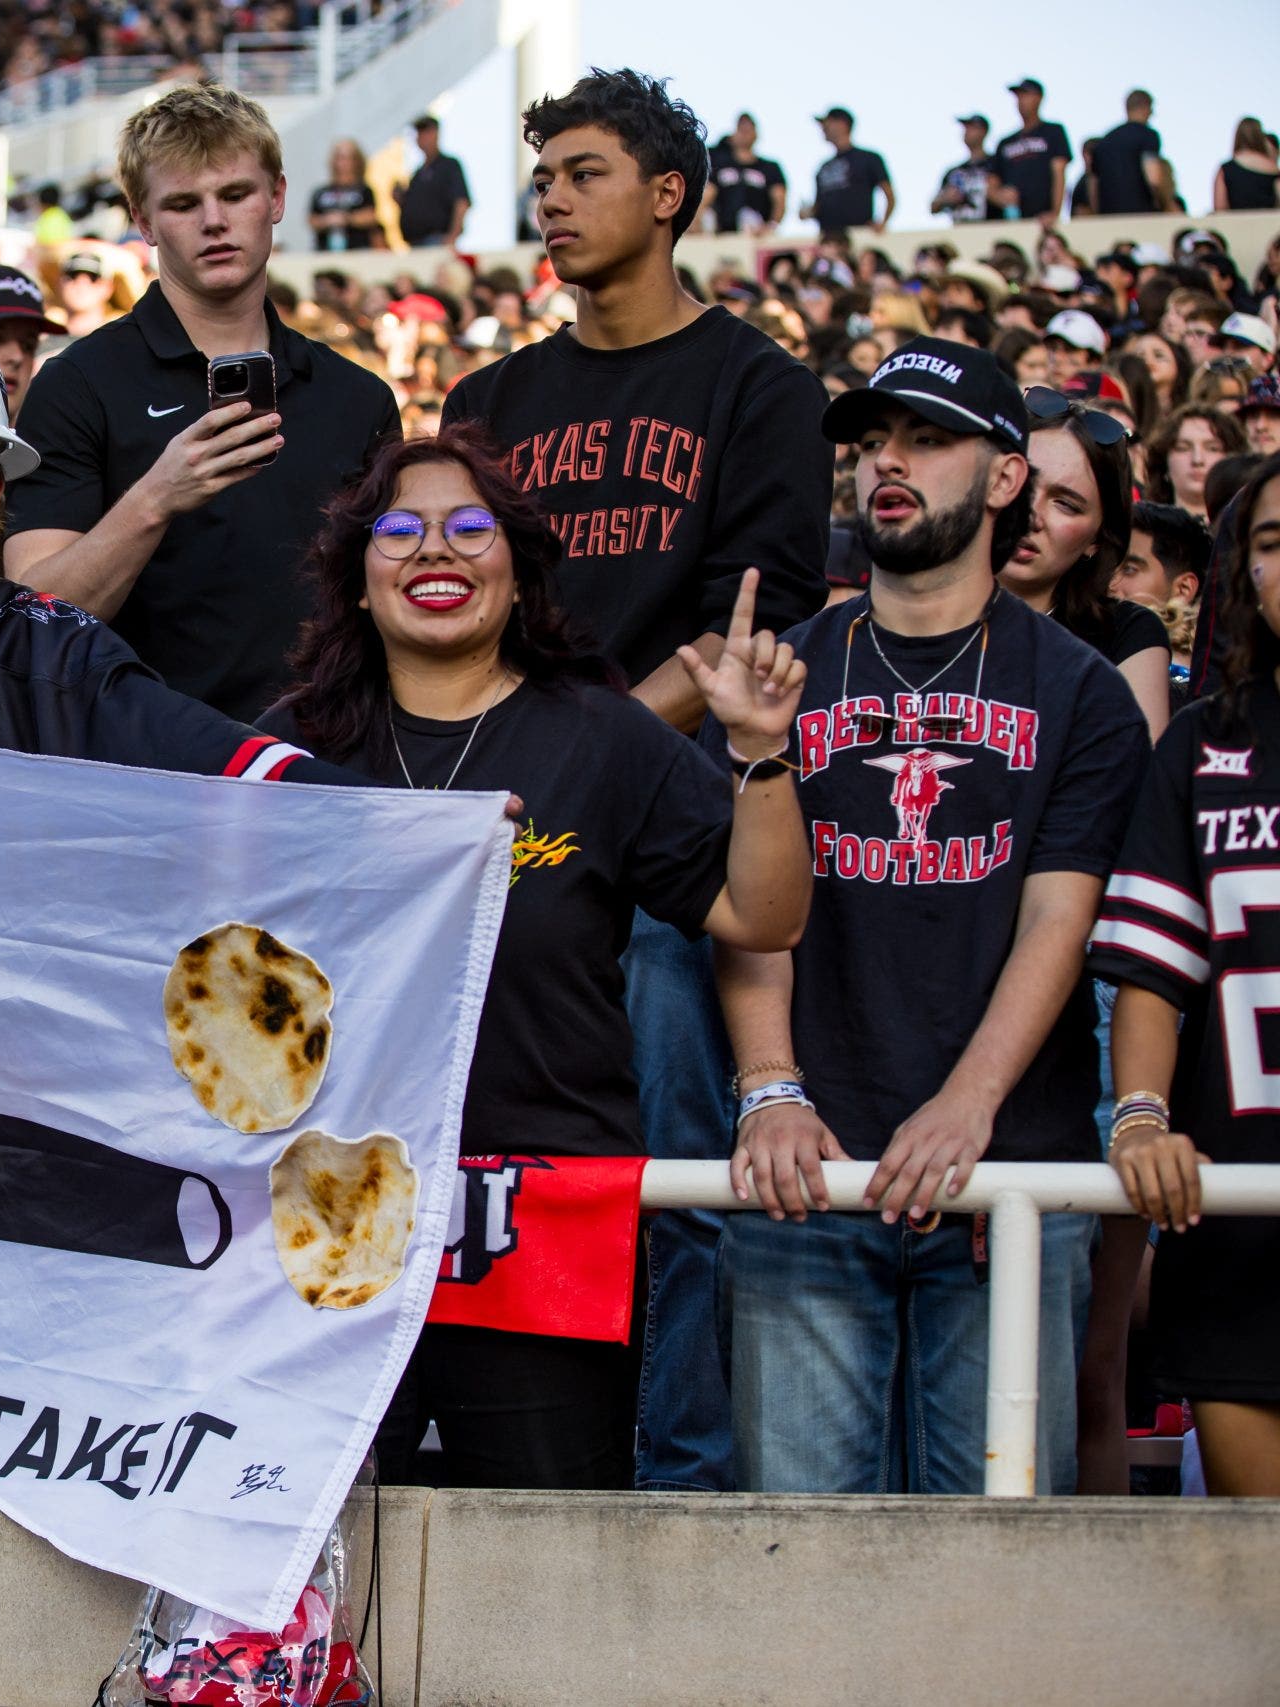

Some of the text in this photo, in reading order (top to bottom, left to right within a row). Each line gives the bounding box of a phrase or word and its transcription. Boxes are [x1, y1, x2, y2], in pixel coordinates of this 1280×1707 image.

[497, 420, 611, 494] EXAS
[798, 693, 1038, 782] RED RAIDER
[813, 819, 1013, 885] FOOTBALL
[148, 1411, 238, 1496] IT
